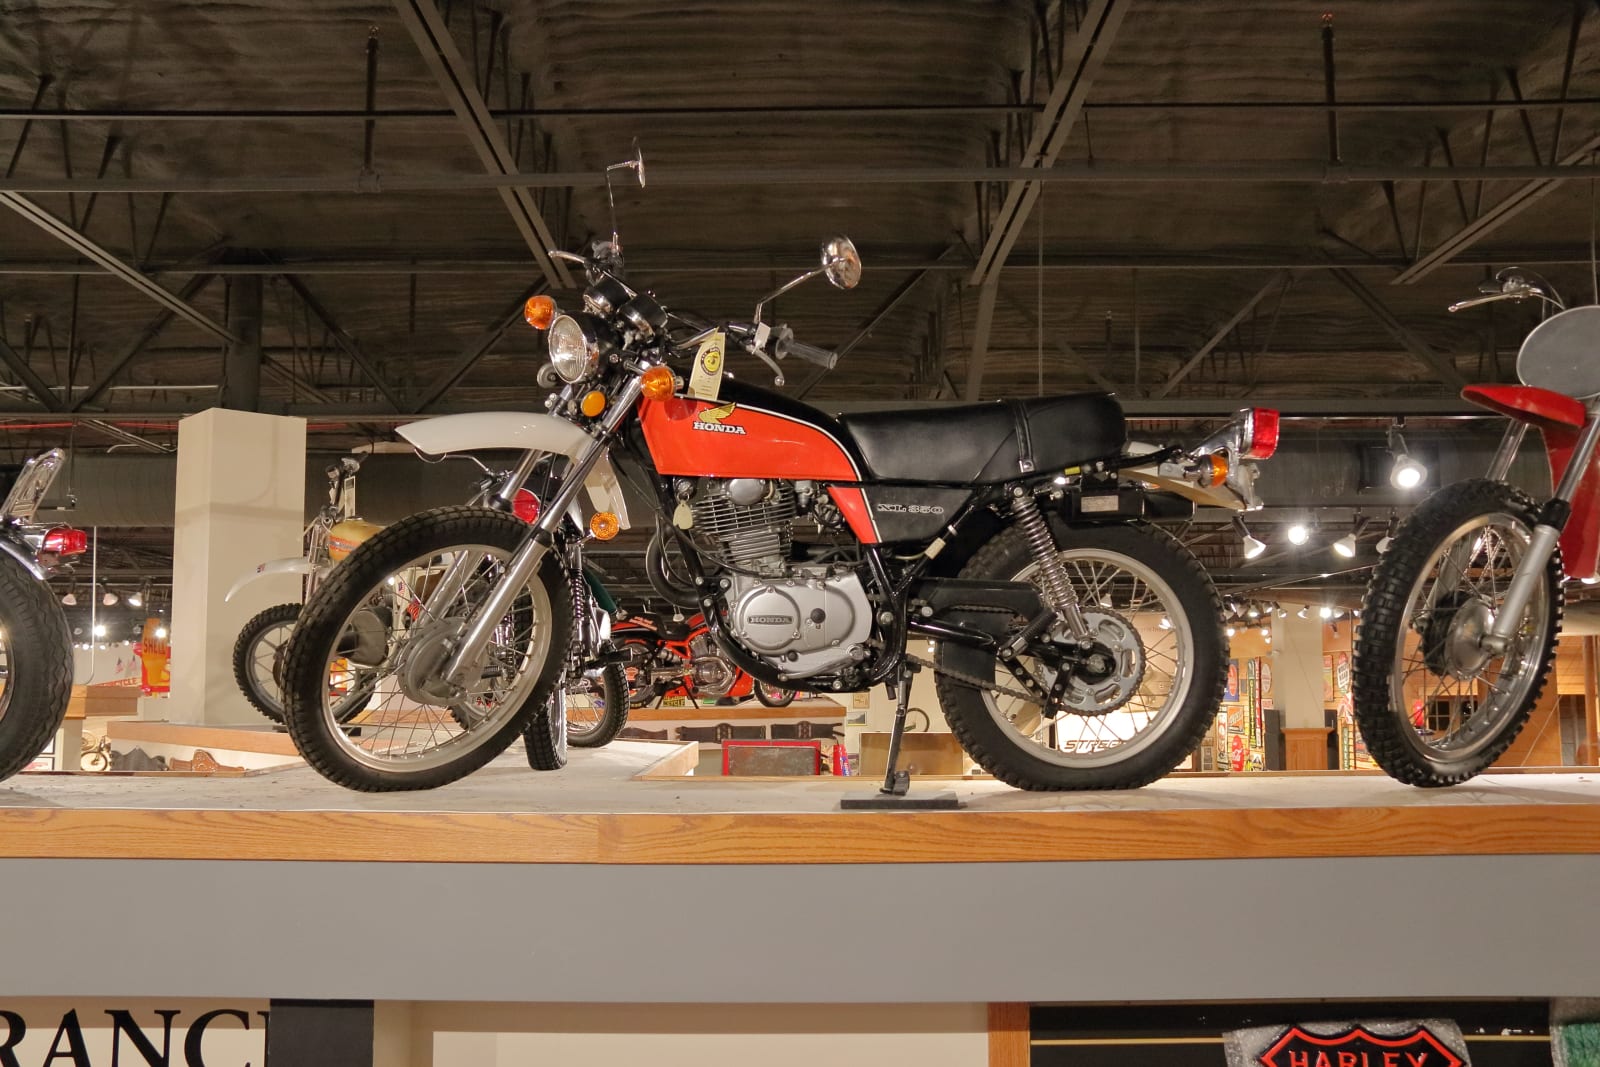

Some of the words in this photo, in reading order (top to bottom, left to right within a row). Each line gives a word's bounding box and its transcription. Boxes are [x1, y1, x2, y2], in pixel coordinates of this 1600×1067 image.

[693, 421, 747, 435] HONDA
[877, 503, 907, 513] XL
[908, 504, 945, 514] 350
[750, 616, 791, 624] HONDA
[143, 638, 167, 655] SHELL
[1289, 1051, 1428, 1067] HARLEY
